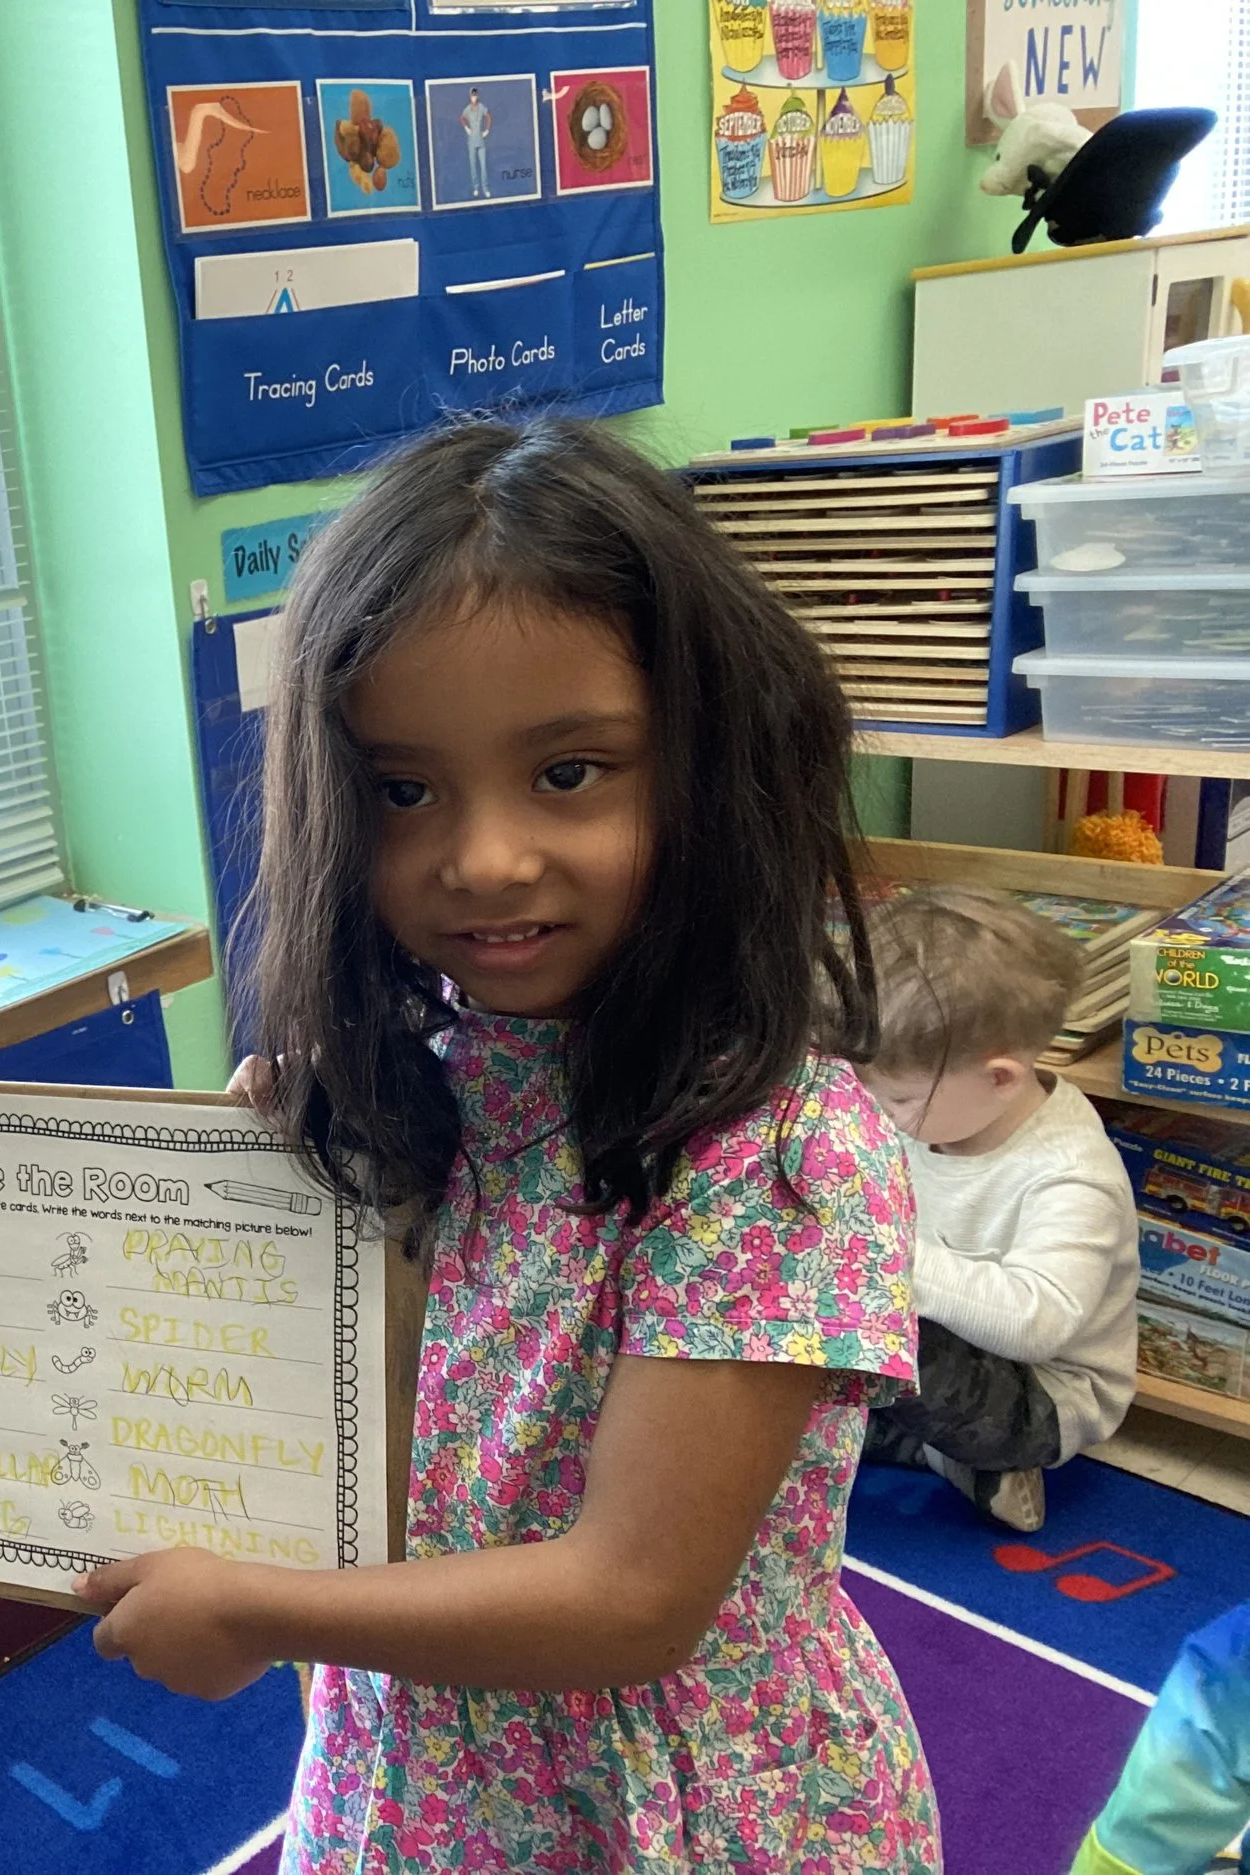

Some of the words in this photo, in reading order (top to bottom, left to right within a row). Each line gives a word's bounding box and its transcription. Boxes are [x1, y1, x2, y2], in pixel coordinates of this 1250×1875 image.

[1025, 25, 1107, 97] NEW
[246, 178, 301, 201] necklace
[501, 166, 534, 181] nurse
[286, 269, 294, 283] 2
[600, 299, 648, 329] Letter
[450, 347, 507, 375] Photo
[511, 336, 556, 367] Cards
[601, 334, 646, 364] Cards
[243, 372, 317, 408] Tracing
[324, 360, 375, 390] Cards
[1093, 402, 1151, 427] Pete
[1089, 428, 1110, 440] the
[1109, 426, 1163, 452] Cat
[233, 539, 281, 578] Daily
[287, 532, 307, 563] S
[1158, 948, 1206, 959] CHILDREN
[1167, 959, 1177, 968] of
[1179, 960, 1195, 969] the
[1145, 1035, 1210, 1063] Pets
[1145, 1065, 1162, 1078] 24
[1167, 1068, 1211, 1086] Pieces
[1230, 1078, 1239, 1090] 2
[1153, 1148, 1197, 1170] GIANT
[1197, 1163, 1232, 1183] FIRE
[16, 1164, 73, 1198] the
[82, 1167, 190, 1206] Room
[10, 1202, 40, 1214] cards.
[42, 1205, 69, 1216] Write
[71, 1206, 87, 1218] the
[90, 1209, 122, 1221] words
[125, 1212, 147, 1223] next
[150, 1213, 161, 1225] to
[164, 1215, 181, 1226] the
[183, 1217, 231, 1232] matching
[235, 1222, 272, 1235] picture
[275, 1224, 313, 1237] below!
[122, 1228, 286, 1278] PRAYING
[152, 1264, 298, 1307] MANTIS
[1180, 1273, 1195, 1287] 10
[1198, 1280, 1225, 1297] Feet
[1199, 1264, 1240, 1285] FLOOR
[119, 1306, 276, 1359] SPIDER
[110, 1415, 326, 1474] DRAGONFLY
[129, 1461, 251, 1524] MOTH
[113, 1509, 321, 1565] LIGHTNING
